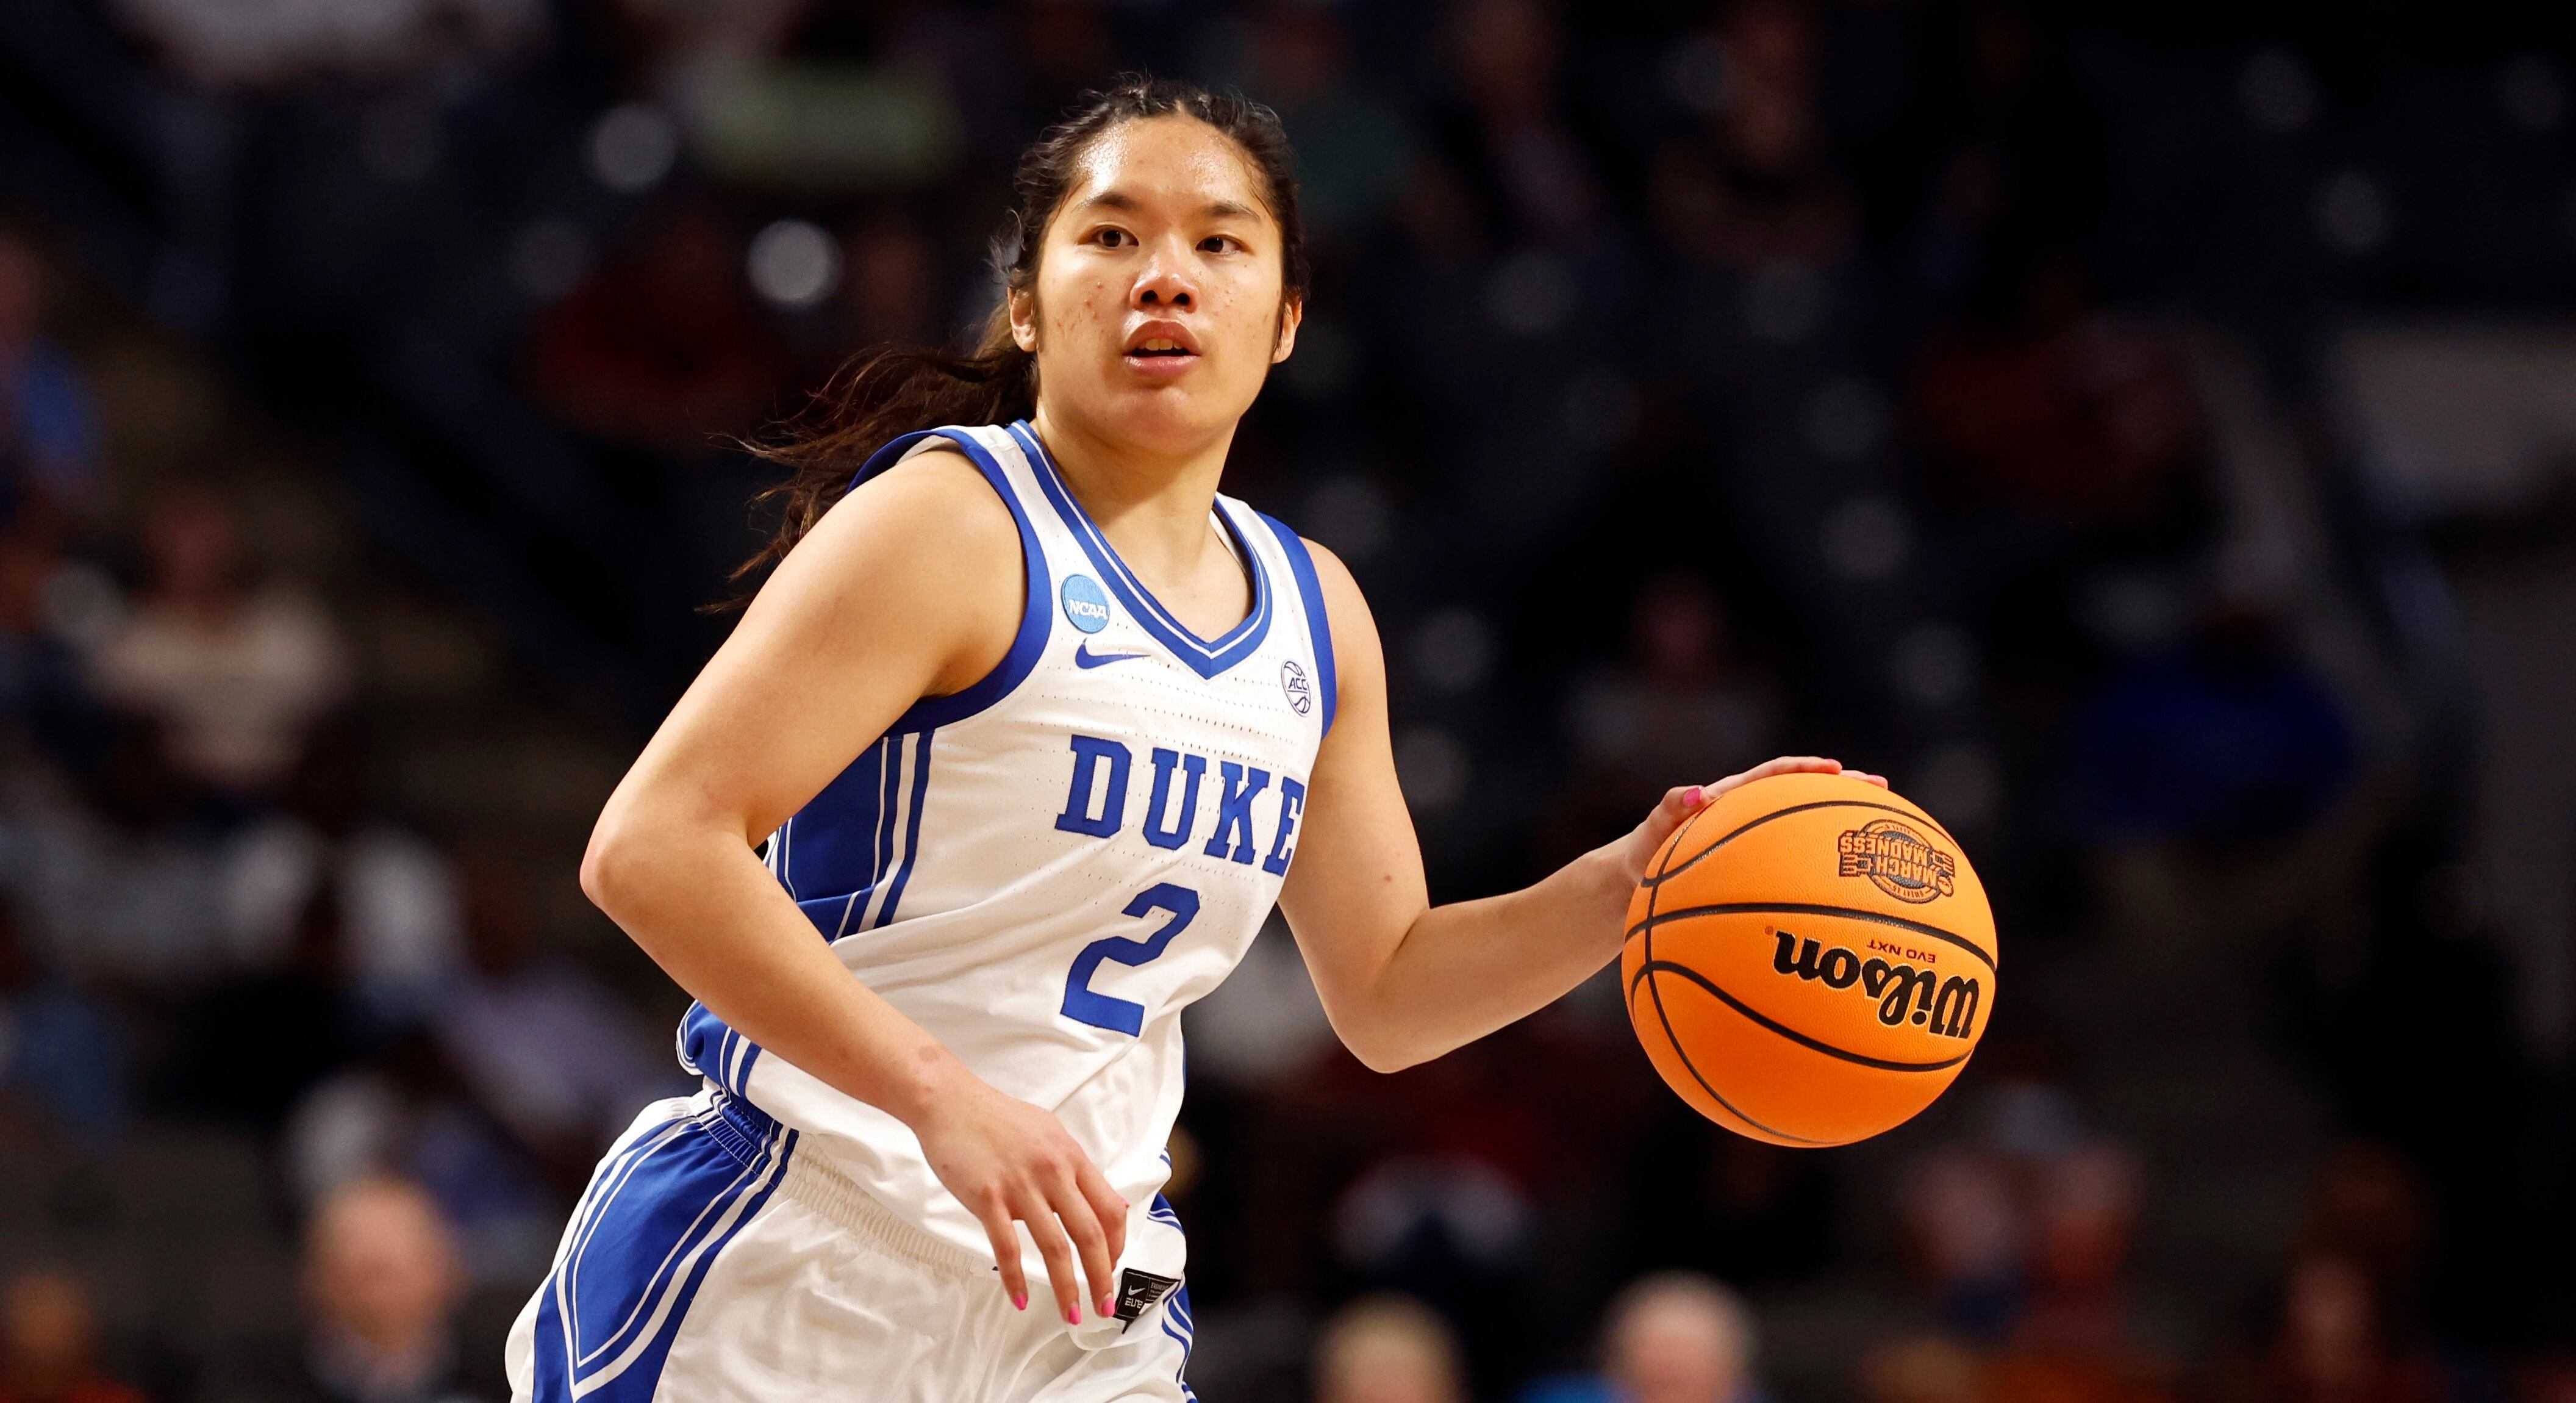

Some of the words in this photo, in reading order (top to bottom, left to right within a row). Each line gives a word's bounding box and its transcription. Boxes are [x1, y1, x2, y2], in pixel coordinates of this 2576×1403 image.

[1068, 599, 1107, 620] NCAA
[1288, 677, 1308, 691] ACC
[1054, 734, 1305, 877] DUKE
[1839, 836, 1927, 867] MADNESS
[1875, 856, 1936, 887] MARCH
[1060, 882, 1200, 1037] 2
[1866, 939, 1901, 955] NXT
[1905, 949, 1936, 963] EVO
[1772, 930, 1979, 1039] Wilson
